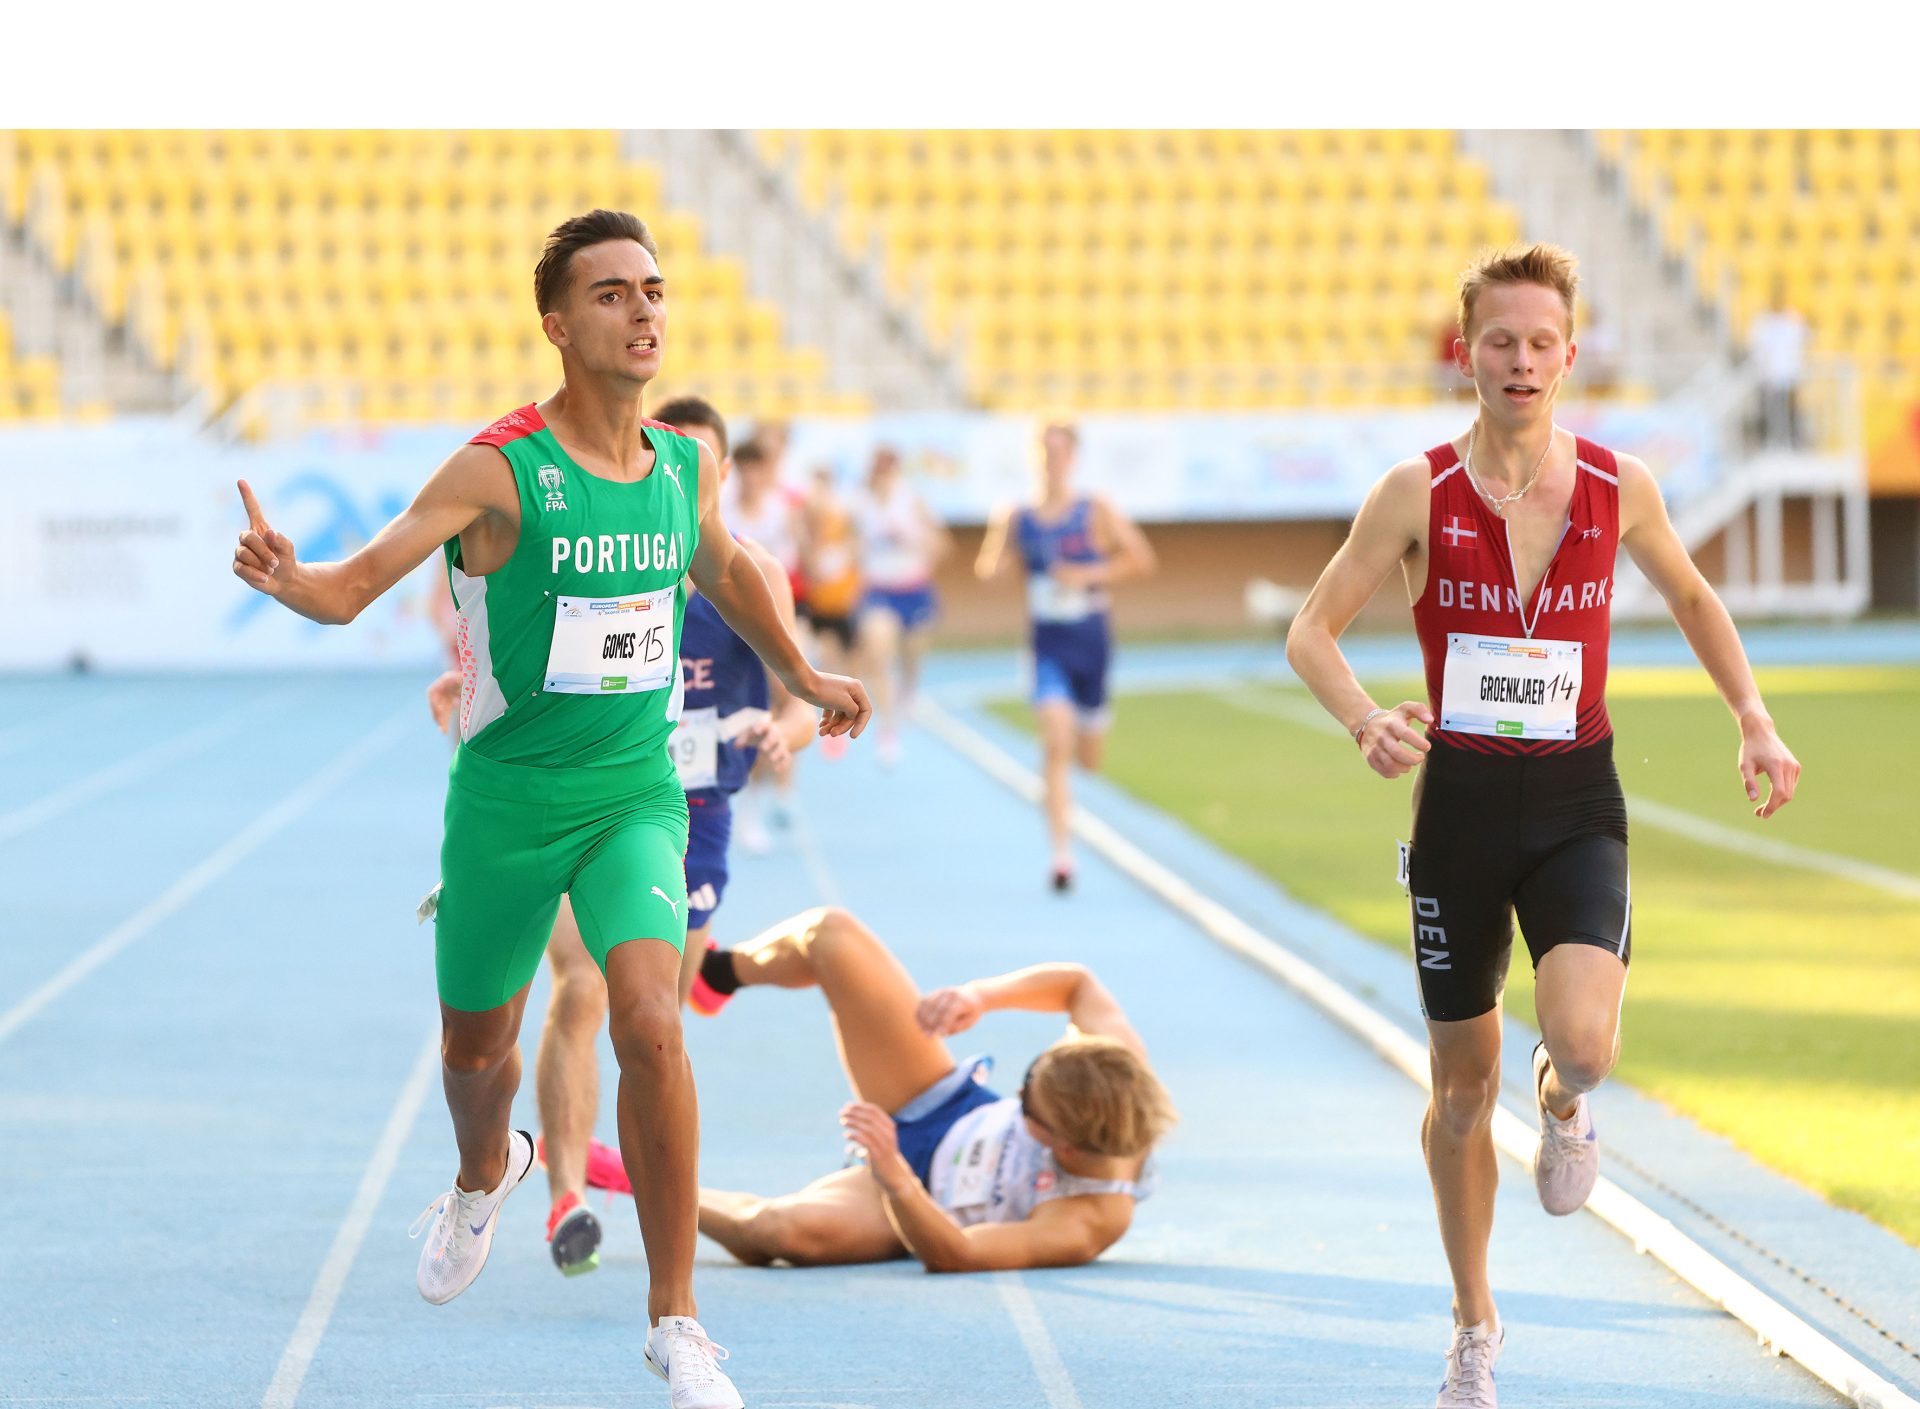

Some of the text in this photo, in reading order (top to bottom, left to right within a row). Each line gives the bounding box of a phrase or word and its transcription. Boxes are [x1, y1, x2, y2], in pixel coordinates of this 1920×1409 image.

[545, 500, 568, 512] FPA
[602, 625, 665, 665] GOMES 15
[1480, 671, 1577, 705] GROENKJAER 14
[1414, 896, 1452, 970] DEN
